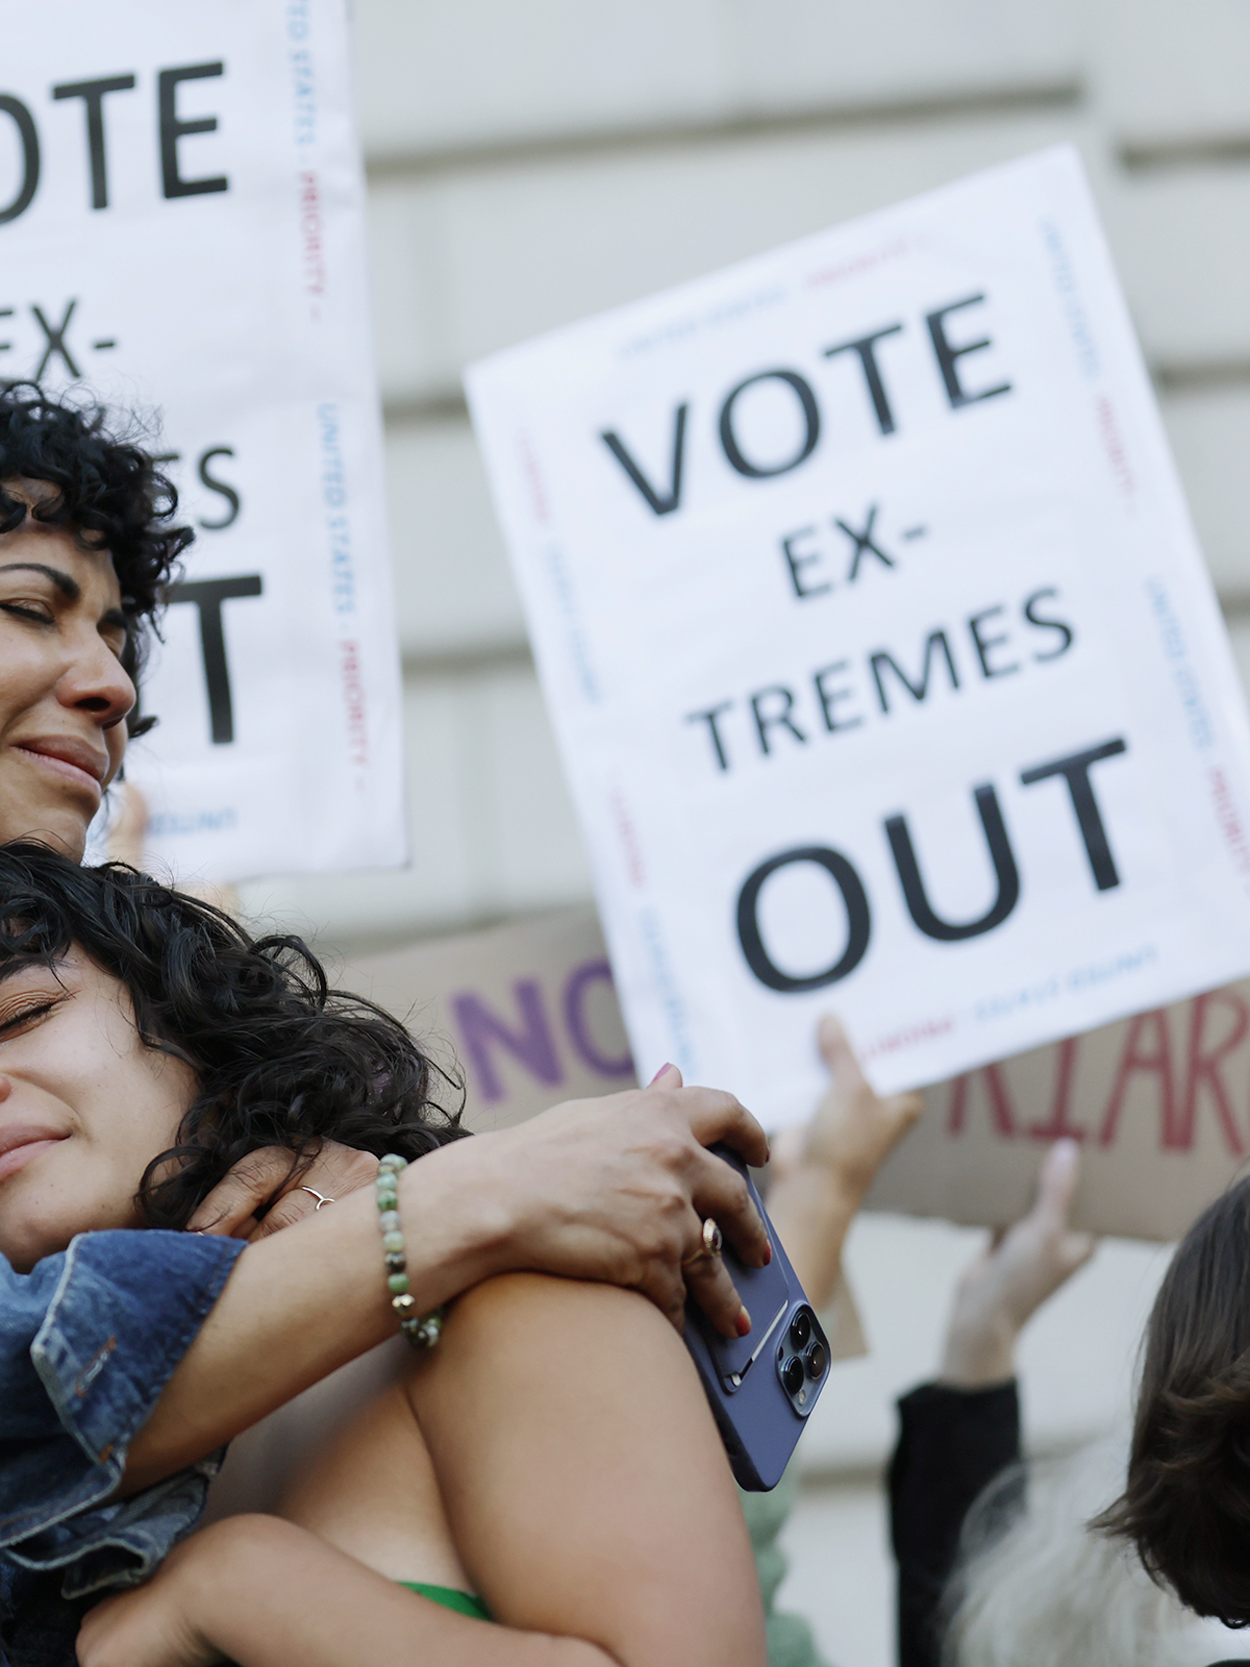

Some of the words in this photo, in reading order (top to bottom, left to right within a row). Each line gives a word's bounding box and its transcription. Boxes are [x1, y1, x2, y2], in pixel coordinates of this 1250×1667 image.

[599, 292, 1014, 519] VOTE
[780, 502, 931, 600] EX-
[684, 586, 1077, 773] TREMES
[732, 736, 1129, 997] OUT
